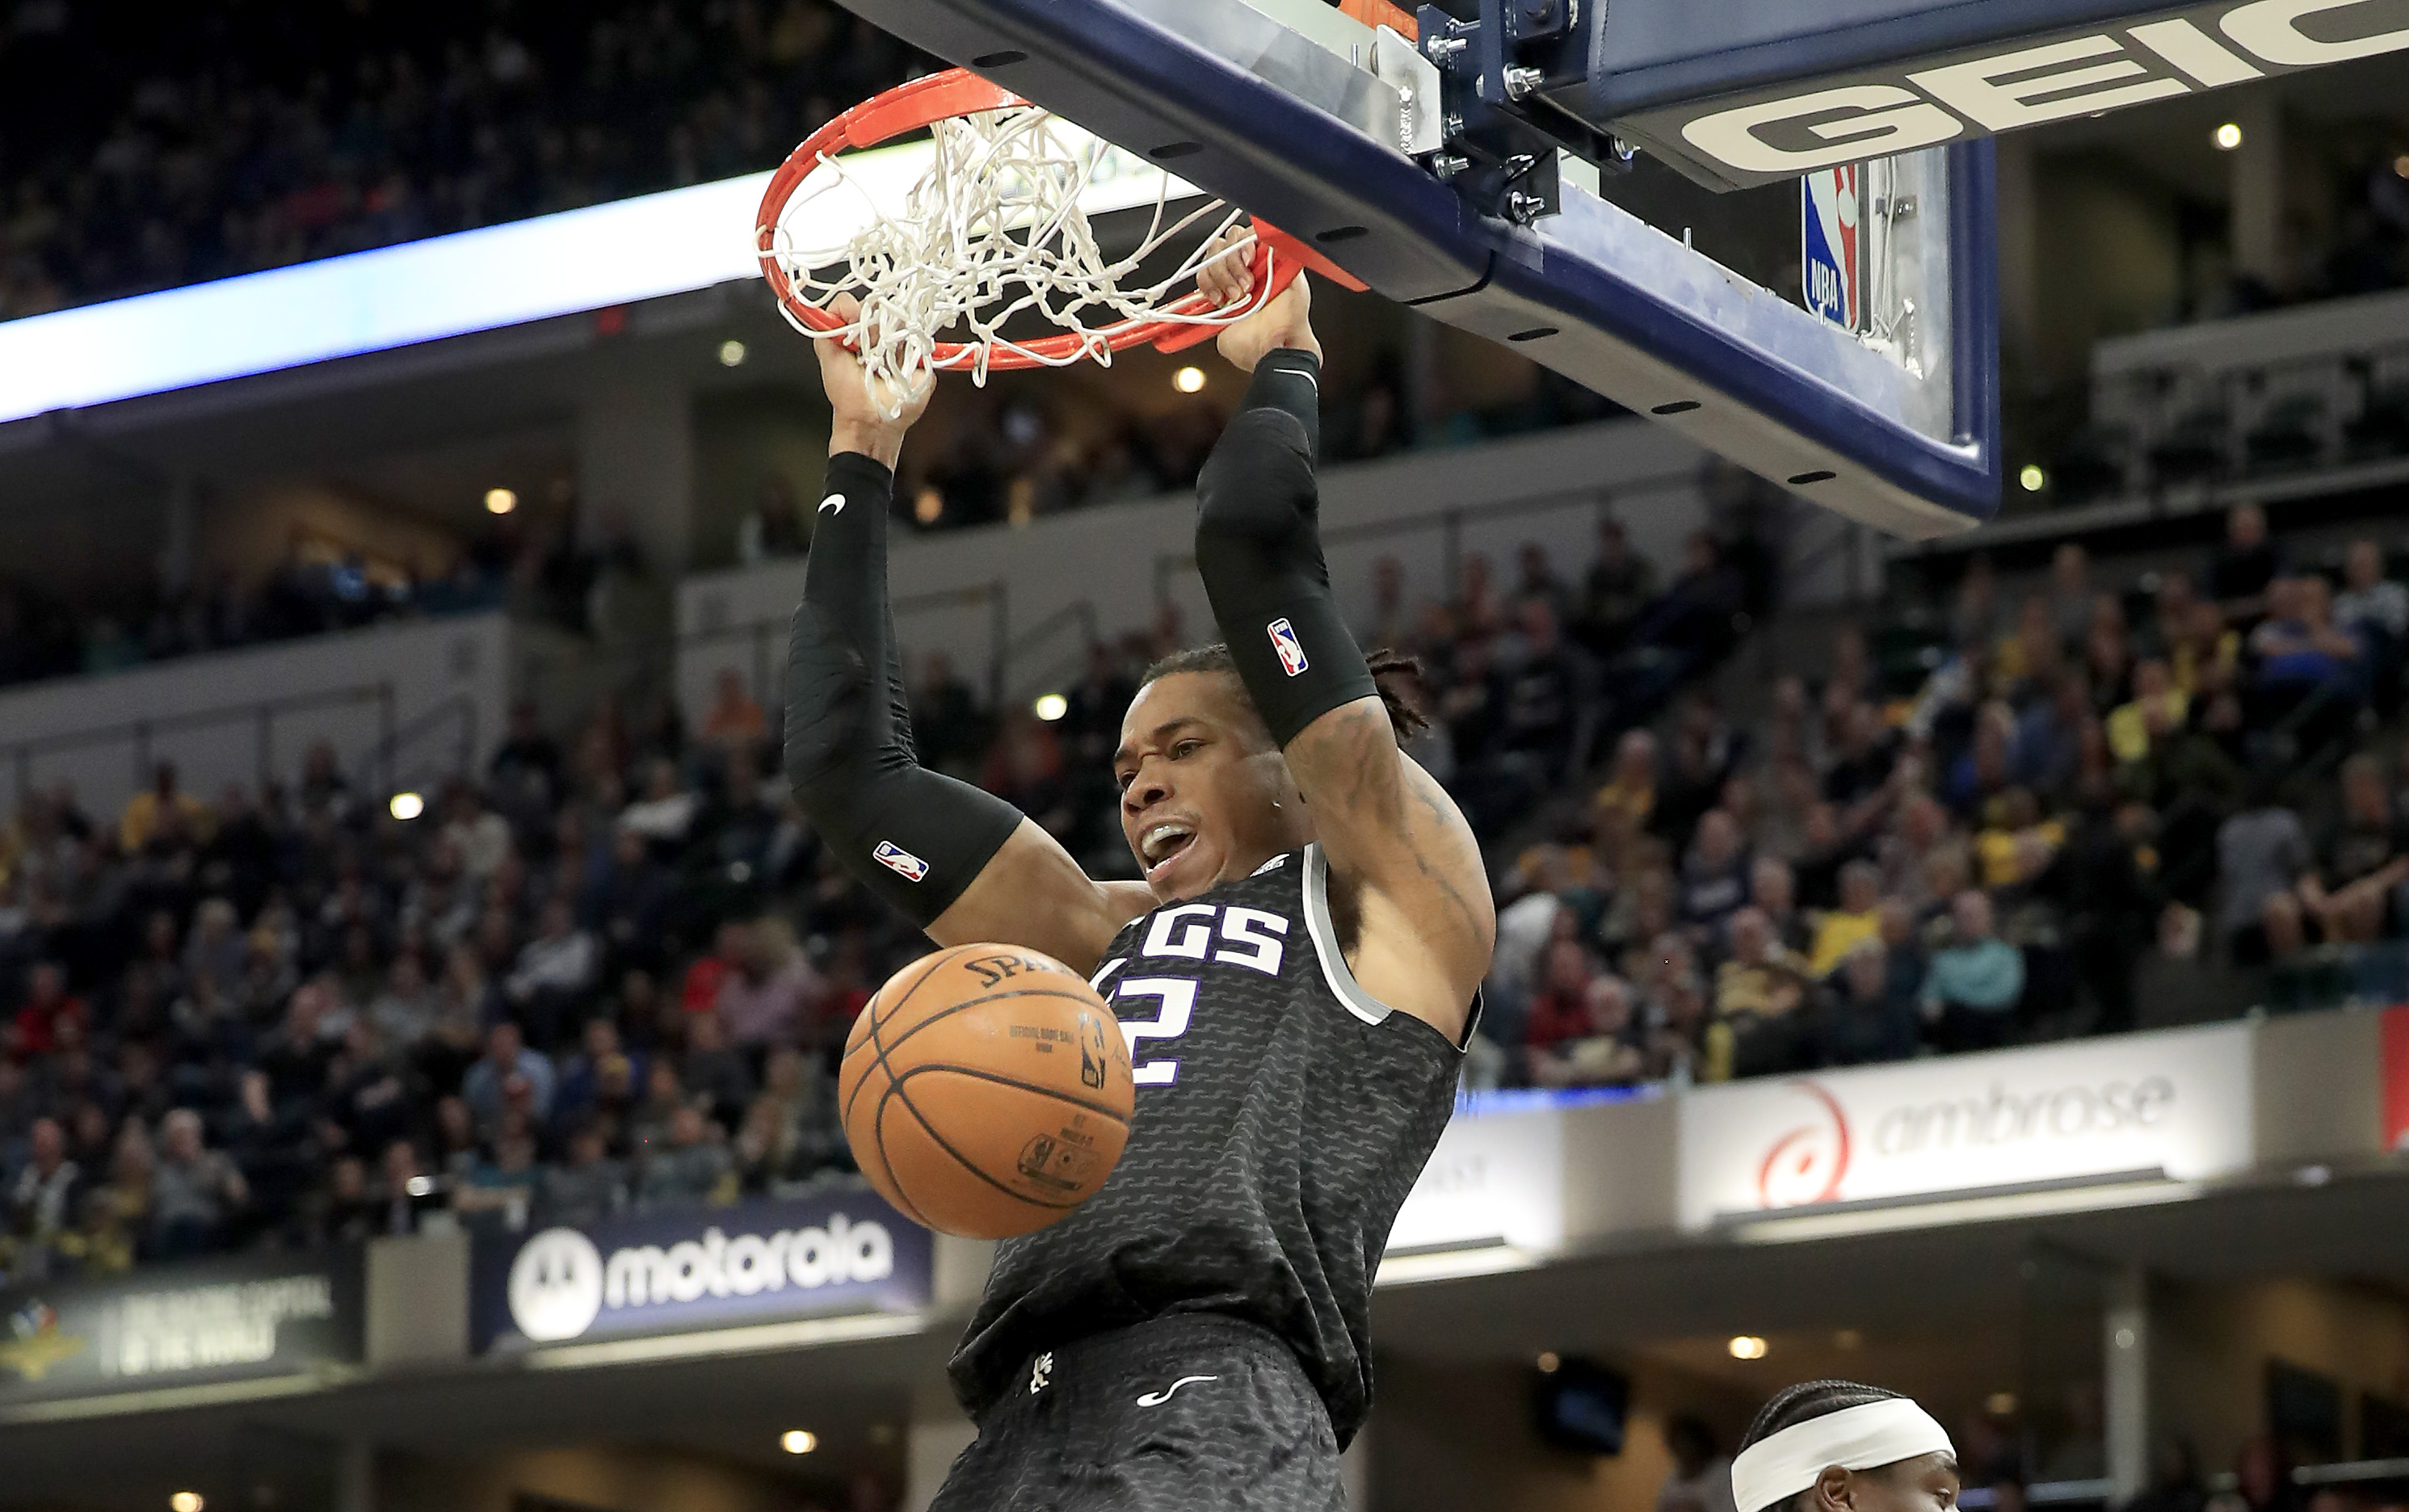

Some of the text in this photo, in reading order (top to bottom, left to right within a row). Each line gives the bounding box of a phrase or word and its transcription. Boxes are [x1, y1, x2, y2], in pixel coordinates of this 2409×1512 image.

[1811, 257, 1839, 312] NBA
[1137, 902, 1290, 979] GS
[1112, 974, 1201, 1087] 2
[1873, 1075, 2176, 1156] ambrose
[606, 1212, 894, 1309] motorola
